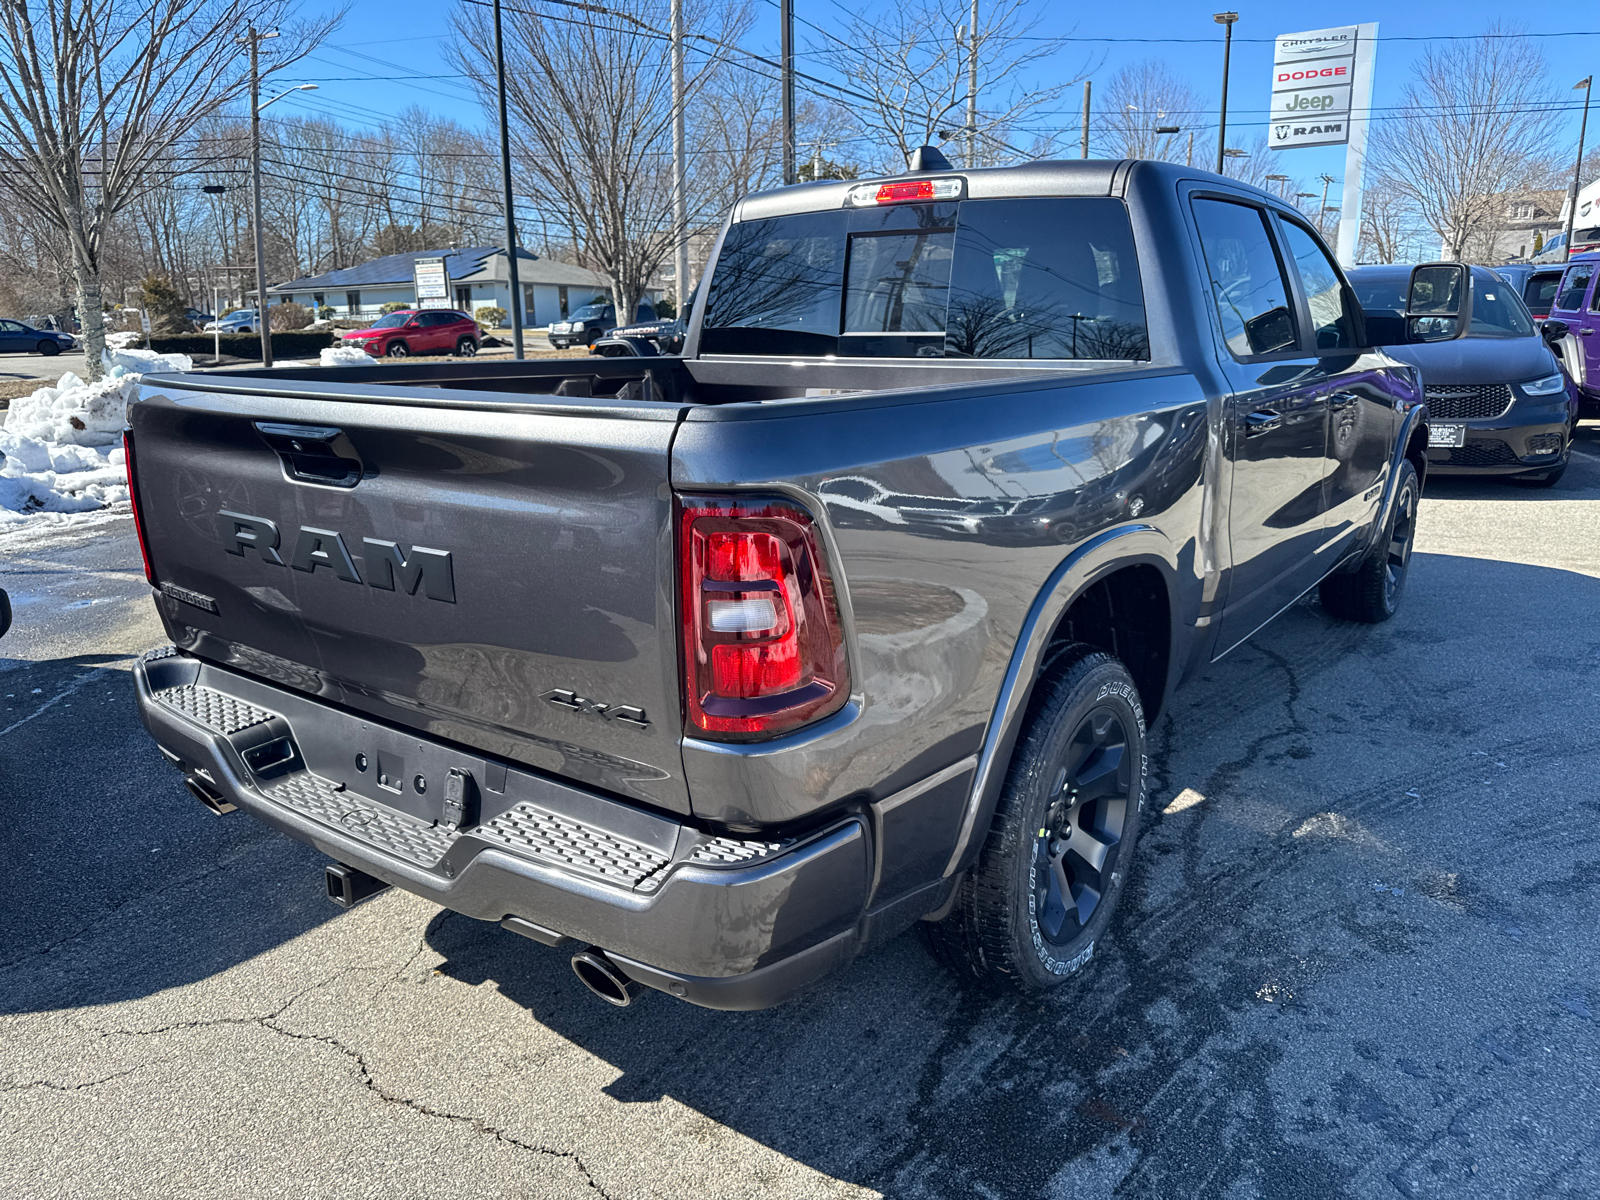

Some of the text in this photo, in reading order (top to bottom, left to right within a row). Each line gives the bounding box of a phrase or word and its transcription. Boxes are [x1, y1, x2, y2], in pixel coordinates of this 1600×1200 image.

[1282, 34, 1348, 48] CHRYSLER
[1278, 66, 1347, 82] DODGE
[1285, 94, 1334, 111] Jeep
[1293, 123, 1342, 136] RAM
[612, 326, 660, 336] RUBICON
[218, 509, 457, 605] RAM
[1096, 681, 1146, 739] DUELER
[1028, 839, 1095, 975] BRIDGESTONE
